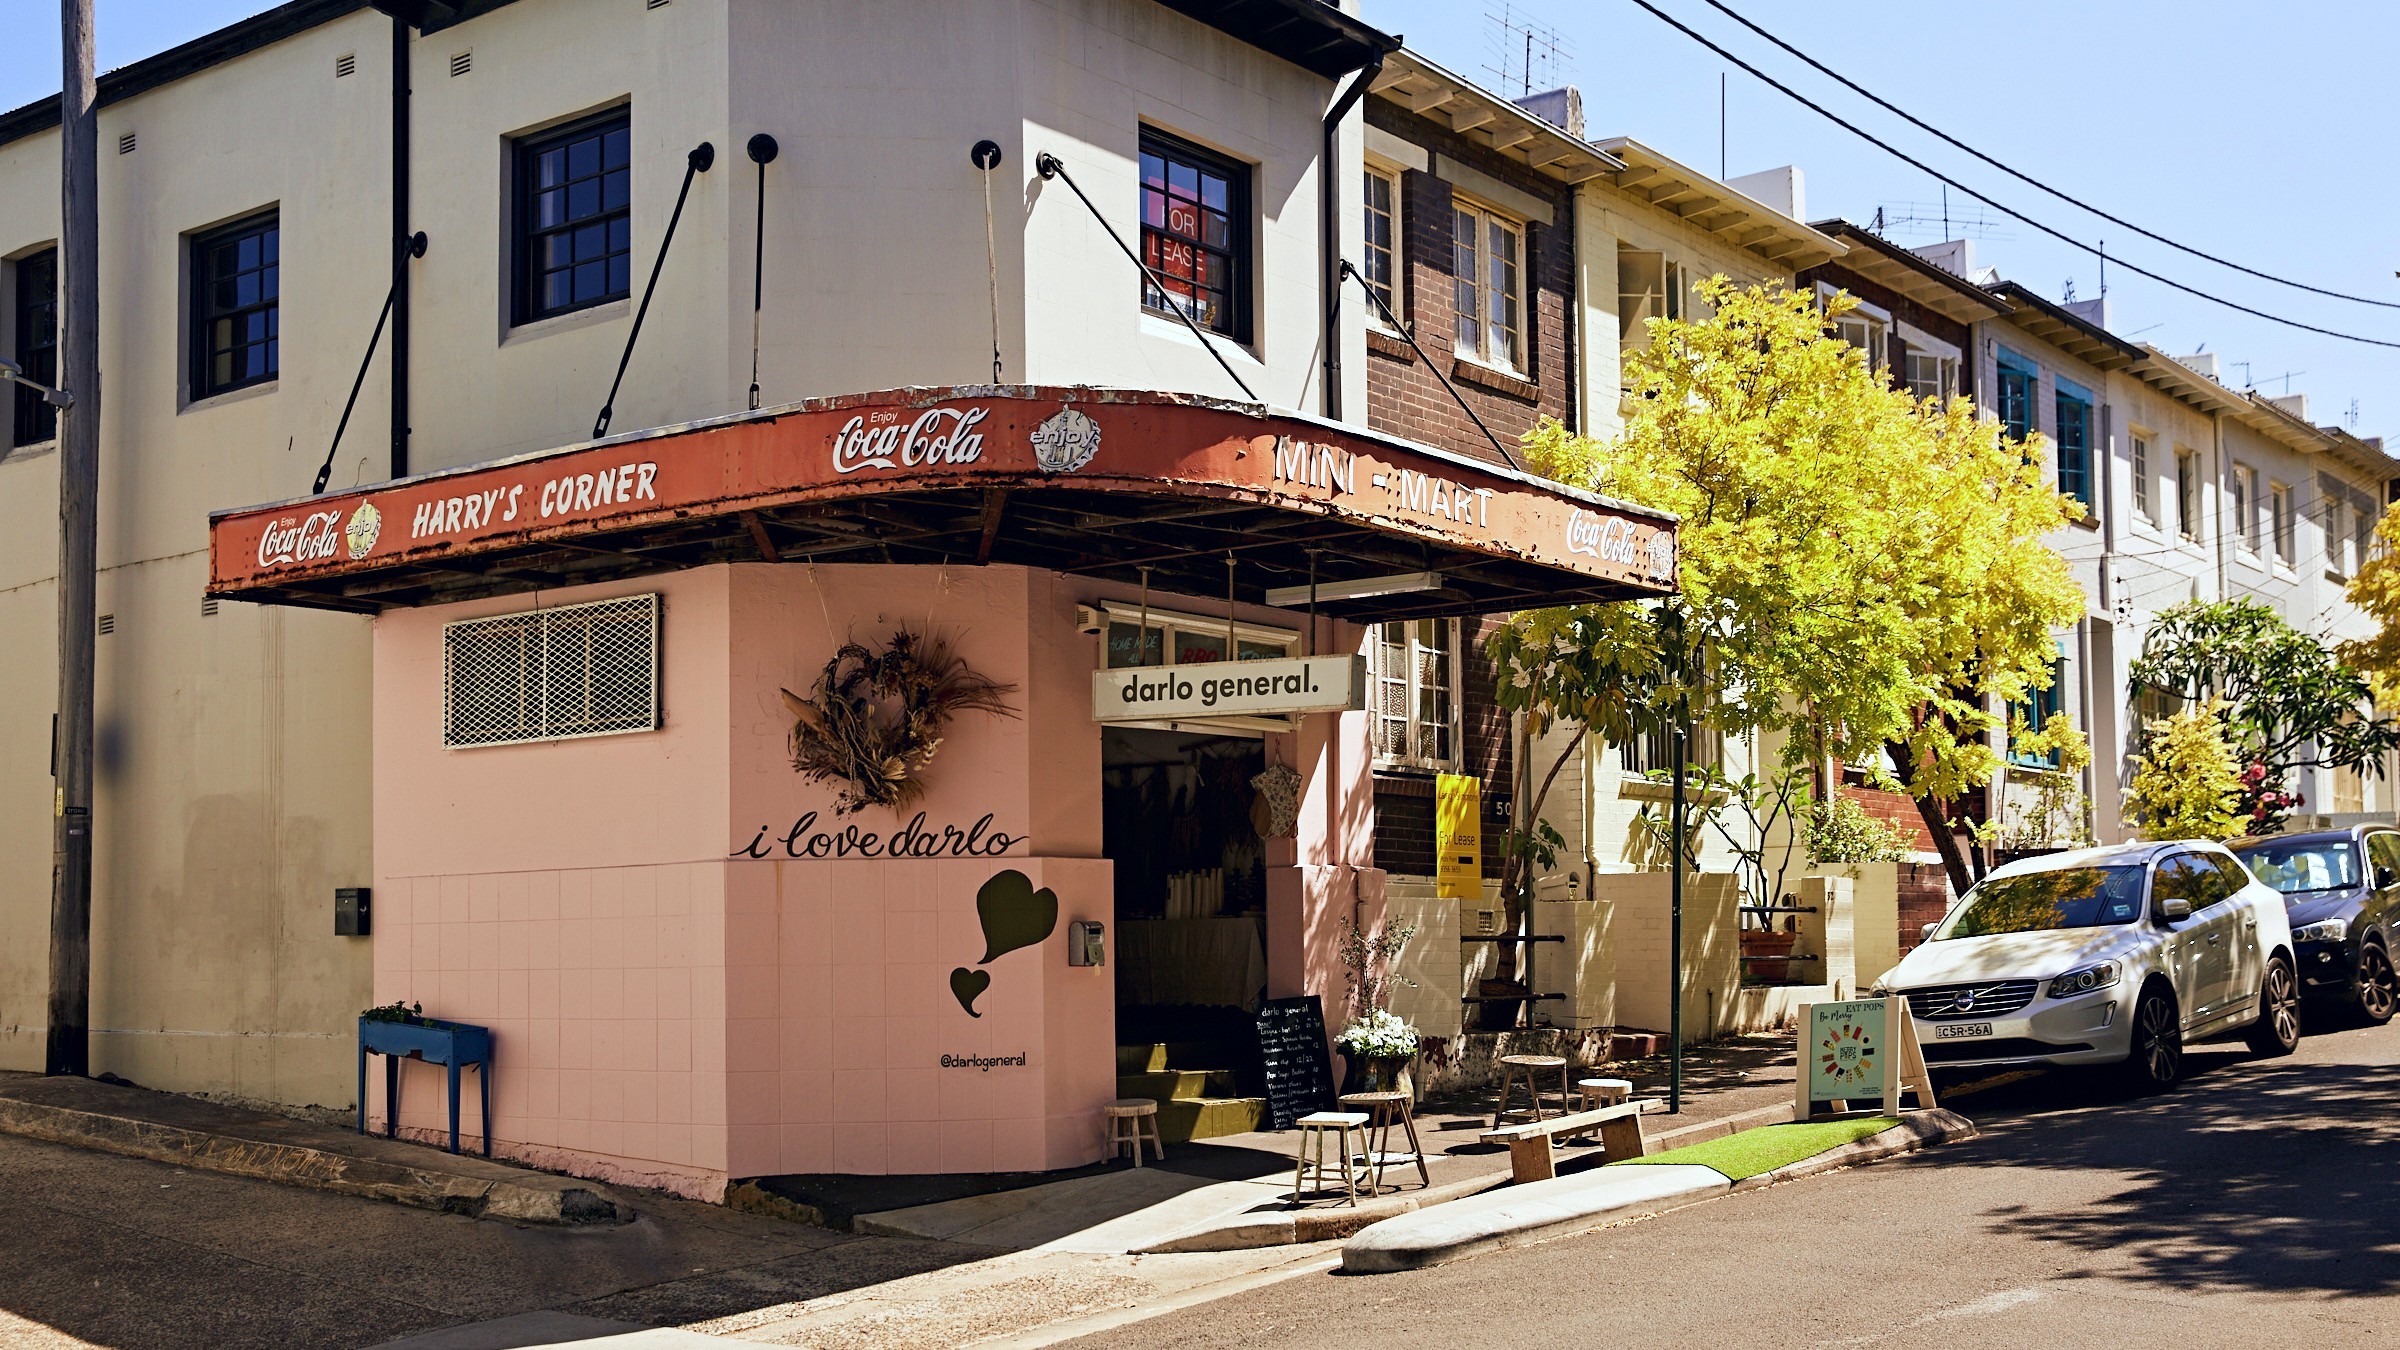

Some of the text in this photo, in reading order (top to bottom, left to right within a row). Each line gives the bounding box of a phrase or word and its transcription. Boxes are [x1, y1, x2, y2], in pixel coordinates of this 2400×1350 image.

[1151, 234, 1204, 271] LEASE
[870, 411, 899, 425] Enjoy
[832, 406, 990, 474] Coca-Cola
[1030, 427, 1099, 450] enjoy
[1275, 435, 1355, 495] MINI
[1401, 468, 1493, 528] MART
[411, 462, 658, 539] HARRY'S CORNER
[258, 509, 342, 568] Coca-Cola
[1566, 508, 1637, 565] Coca-Cola
[1134, 635, 1158, 649] MDE
[1121, 663, 1319, 706] darlo general.
[1496, 801, 1512, 816] 50
[730, 811, 1030, 859] i love darlo
[1440, 831, 1476, 846] For Lease
[1261, 1007, 1279, 1017] darlo
[1831, 1010, 1853, 1022] Merry
[1846, 1002, 1885, 1013] EAT POPS
[941, 1051, 1026, 1072] @darlogeneral
